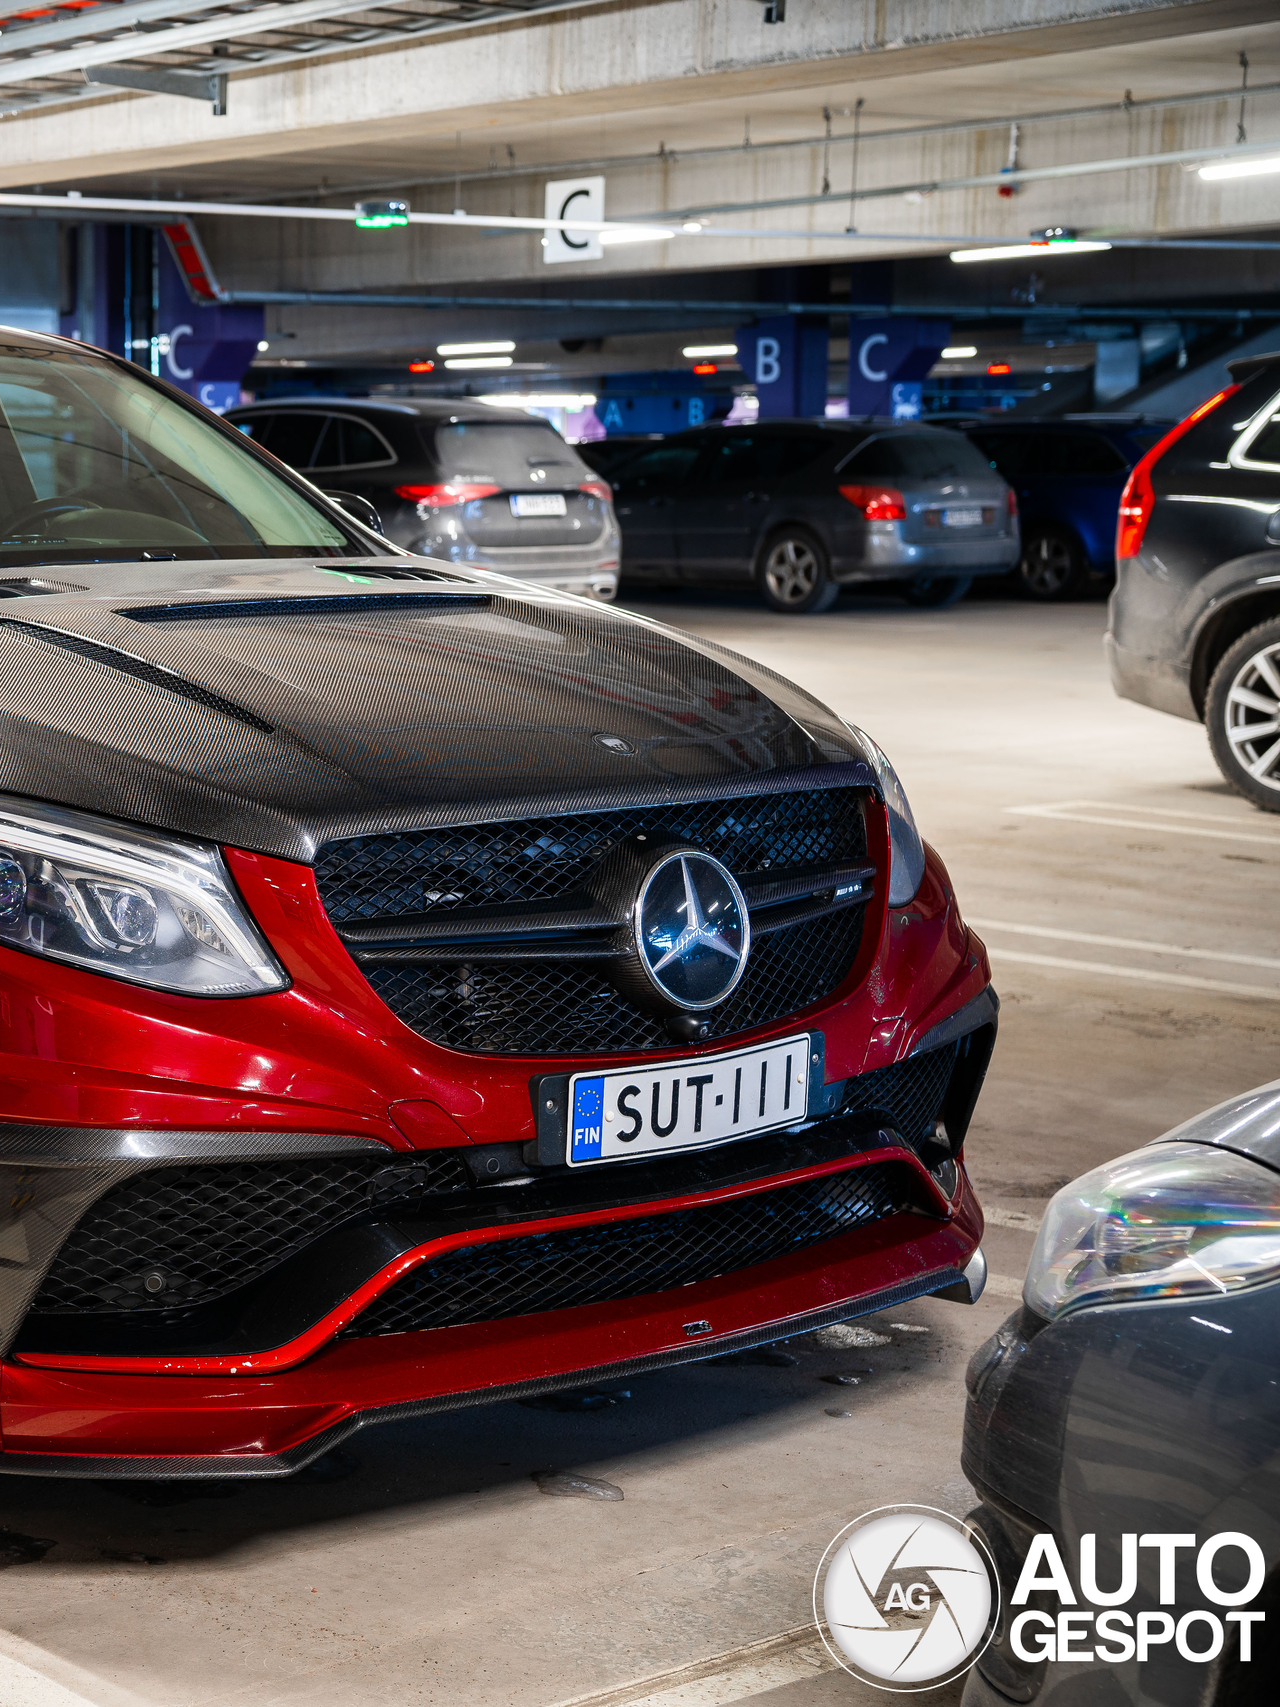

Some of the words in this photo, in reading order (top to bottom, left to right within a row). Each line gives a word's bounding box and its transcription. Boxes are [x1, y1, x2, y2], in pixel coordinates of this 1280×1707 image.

[559, 189, 590, 249] C
[166, 324, 194, 379] C
[756, 337, 781, 384] B
[858, 333, 888, 382] C
[201, 384, 215, 406] C
[603, 399, 623, 428] A
[688, 397, 705, 426] B
[575, 1126, 600, 1146] FIN
